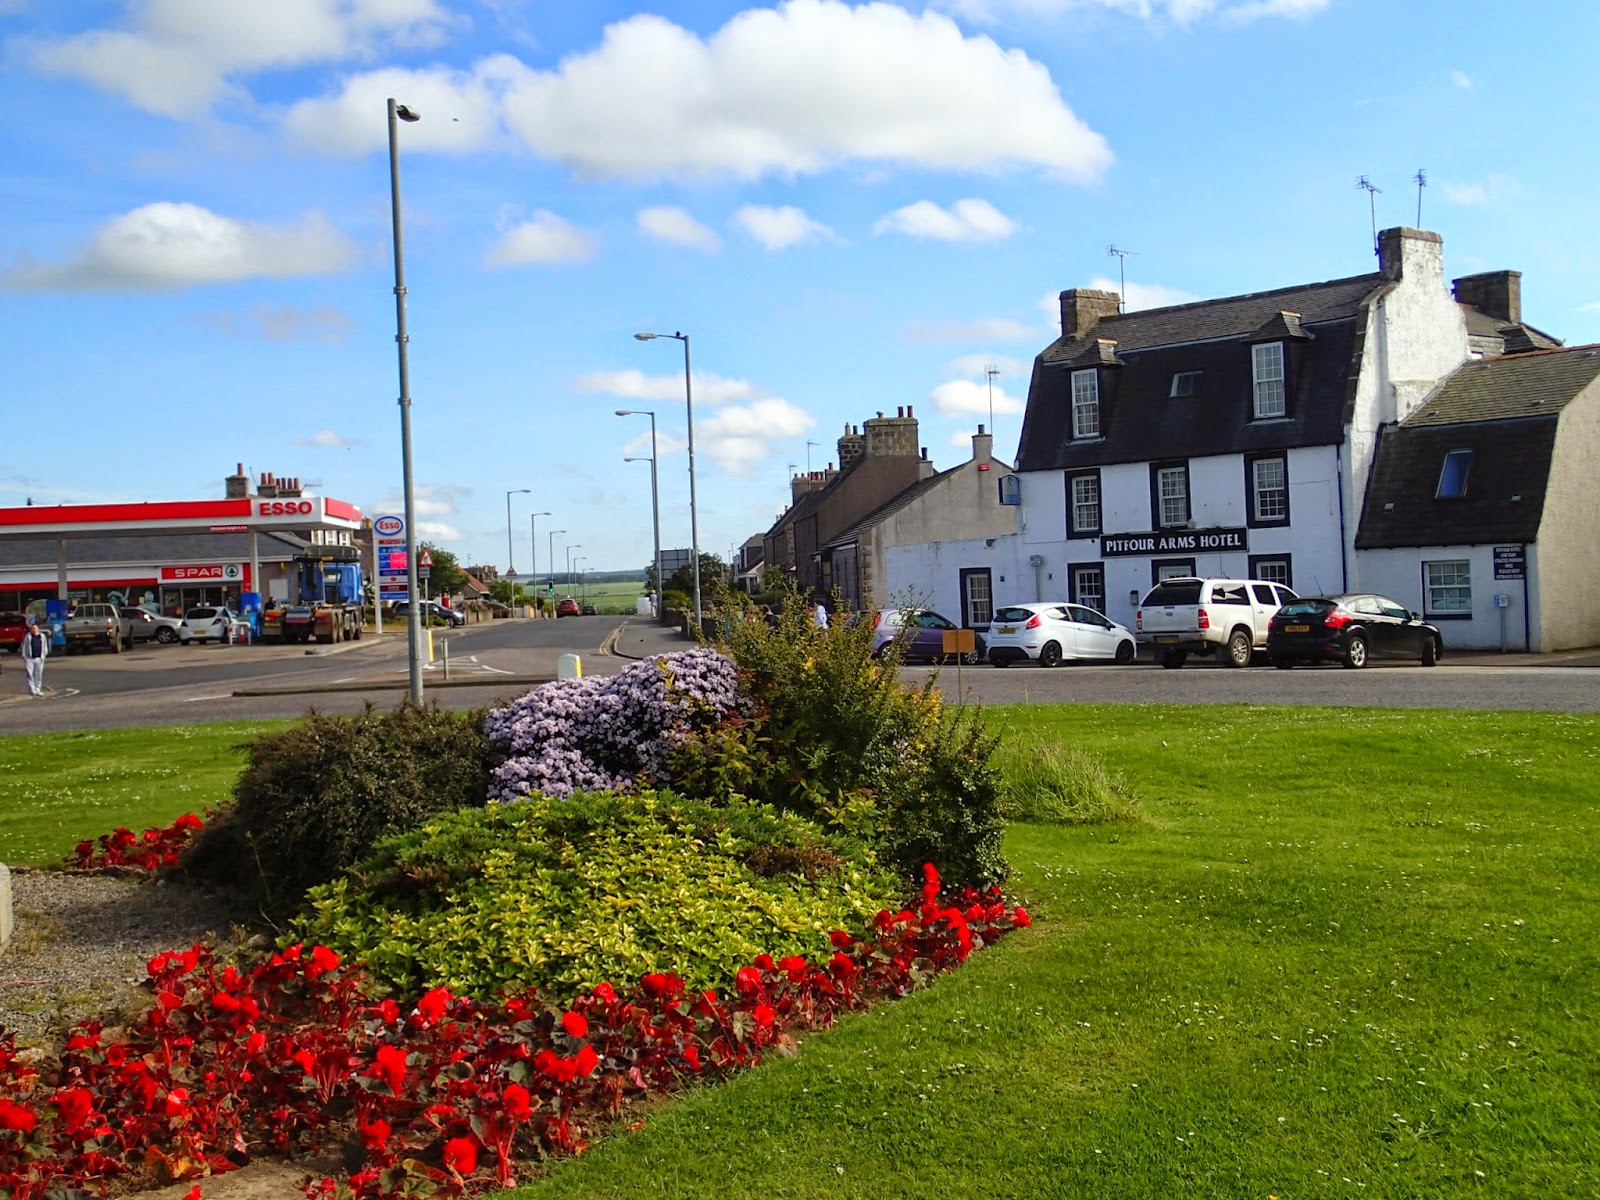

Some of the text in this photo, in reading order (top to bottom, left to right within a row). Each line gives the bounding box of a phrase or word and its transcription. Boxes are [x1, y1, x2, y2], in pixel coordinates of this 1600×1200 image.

[259, 501, 312, 516] ESSO
[379, 521, 400, 529] Esso
[1106, 533, 1241, 552] PITFOUR ARMS HOTEL
[174, 567, 222, 577] SPAR
